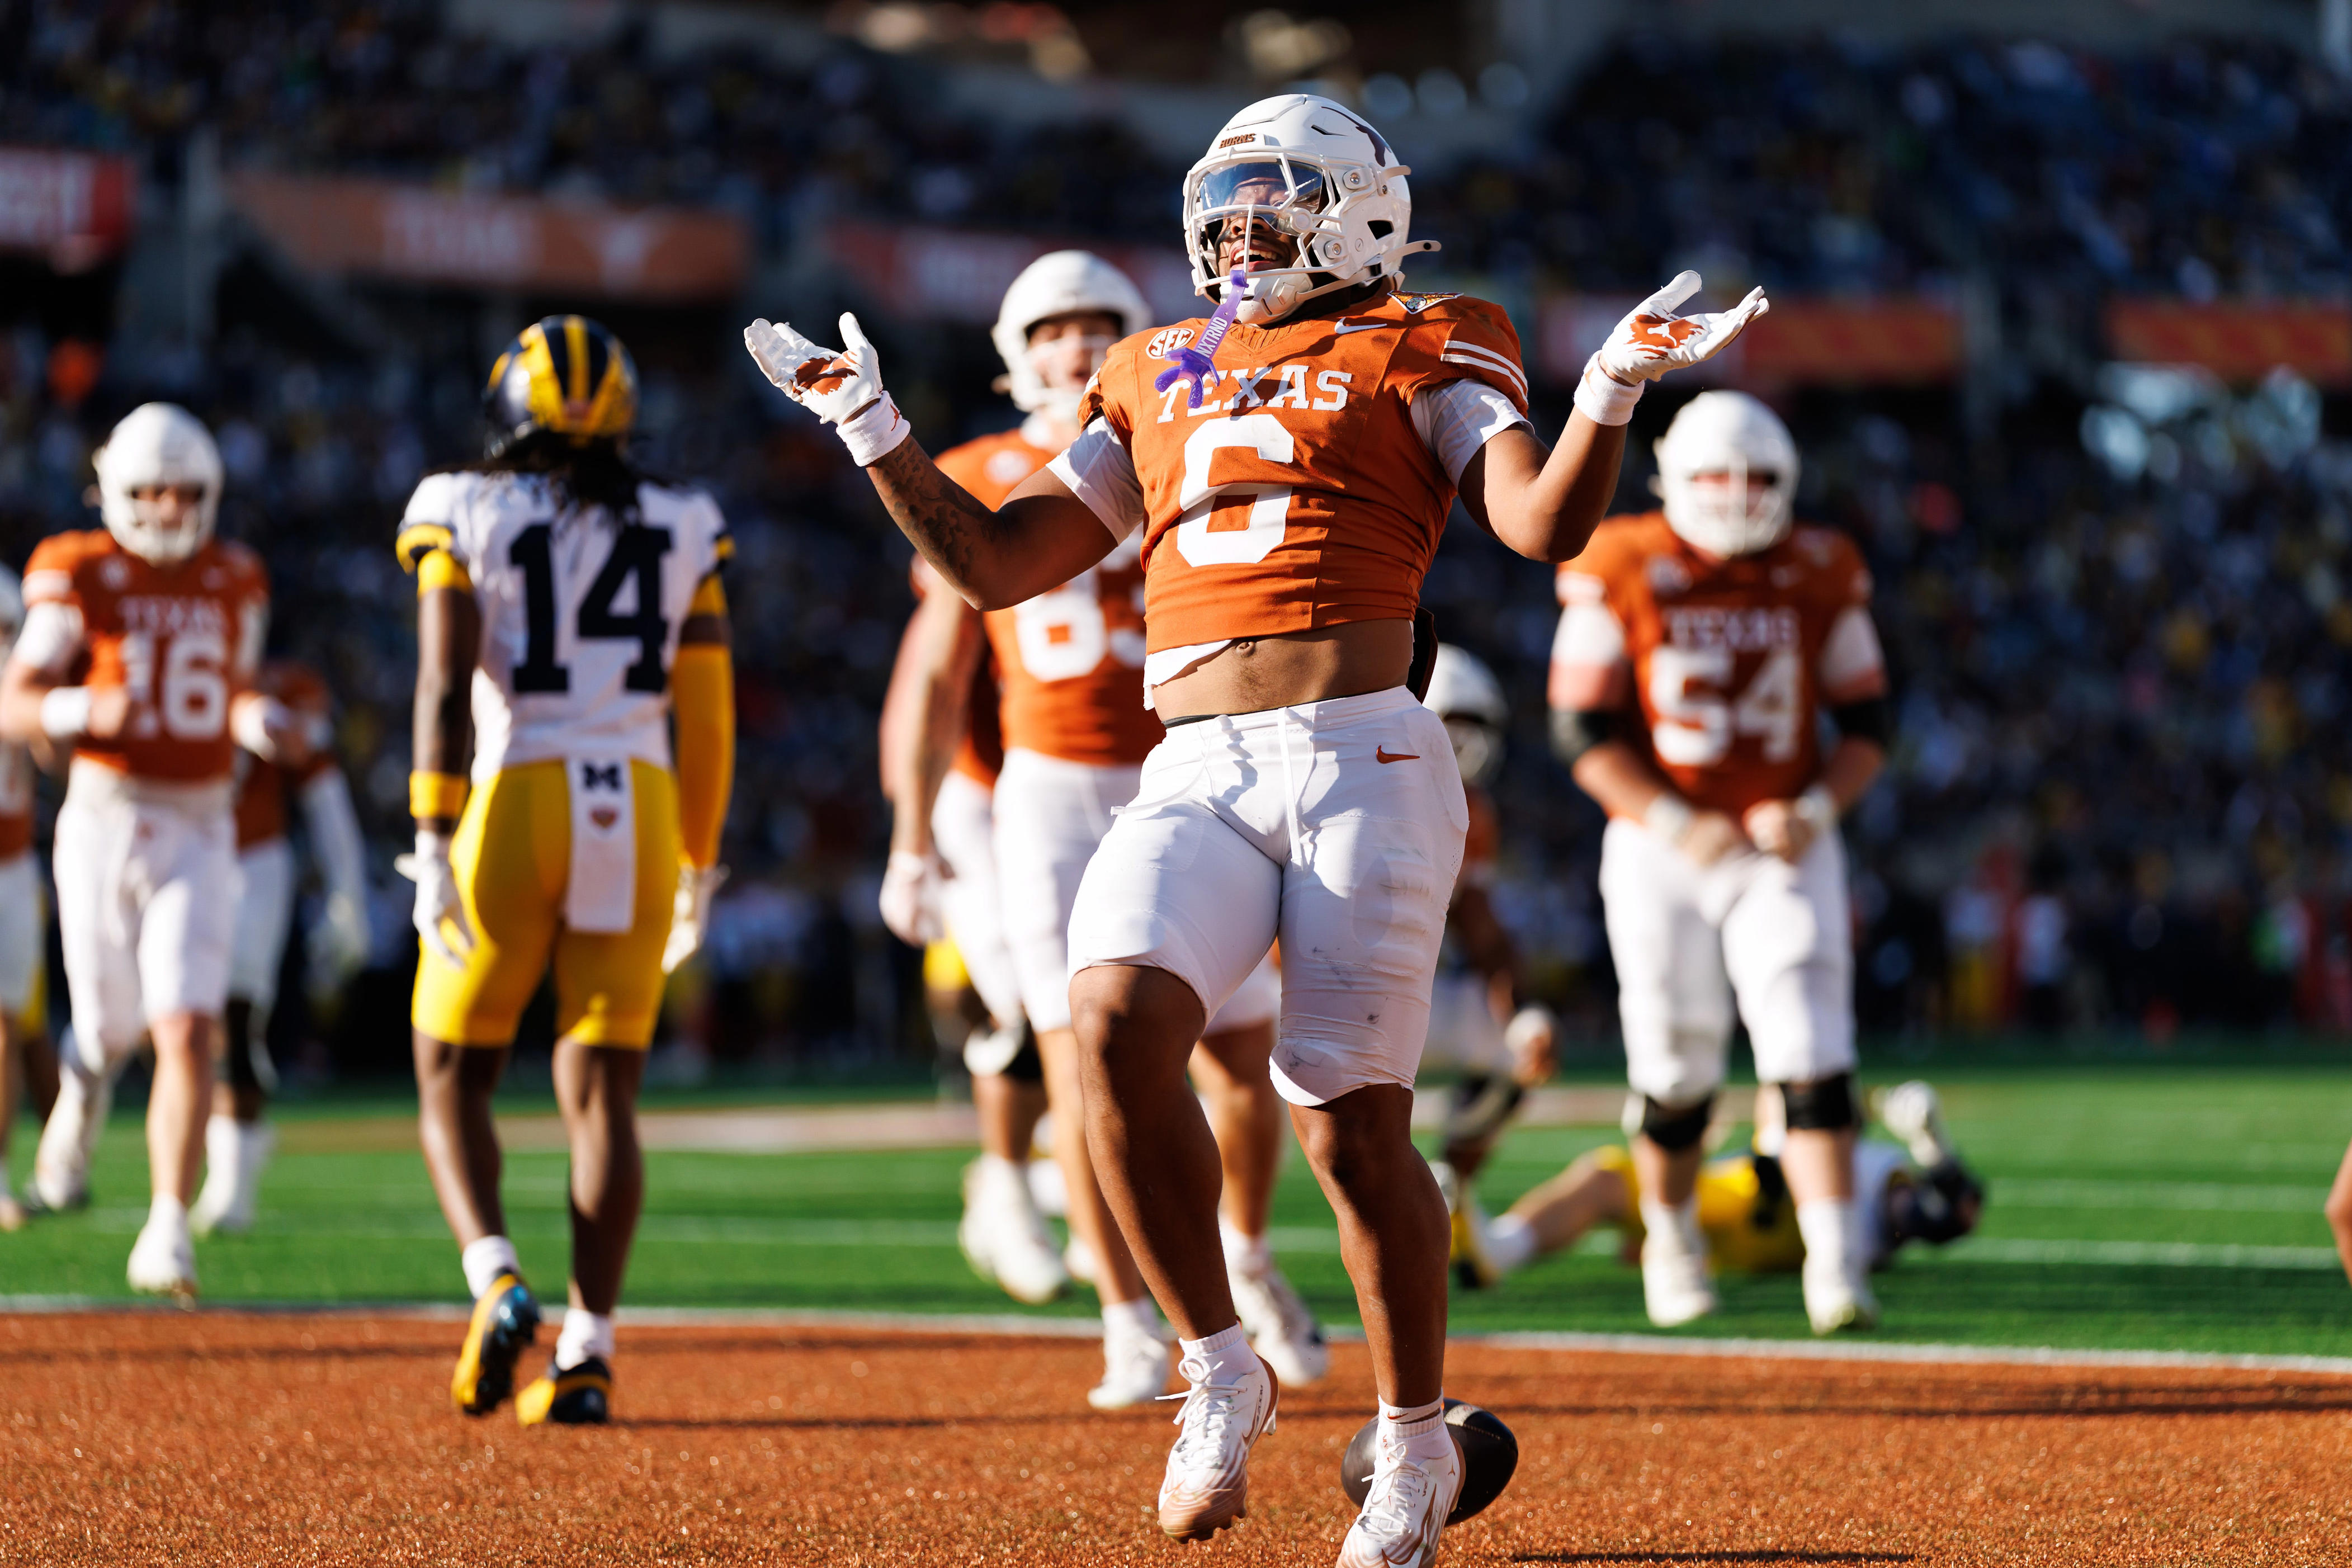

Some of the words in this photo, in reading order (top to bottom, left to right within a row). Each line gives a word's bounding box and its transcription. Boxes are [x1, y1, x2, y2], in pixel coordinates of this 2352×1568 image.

[1218, 133, 1257, 149] HORNS
[1150, 329, 1191, 357] SEC
[1196, 317, 1228, 358] NXTRND
[1157, 365, 1352, 424] TEXAS
[1177, 414, 1294, 568] 6
[509, 523, 674, 693] 14
[121, 631, 228, 740] 16
[1650, 644, 1805, 765] 54
